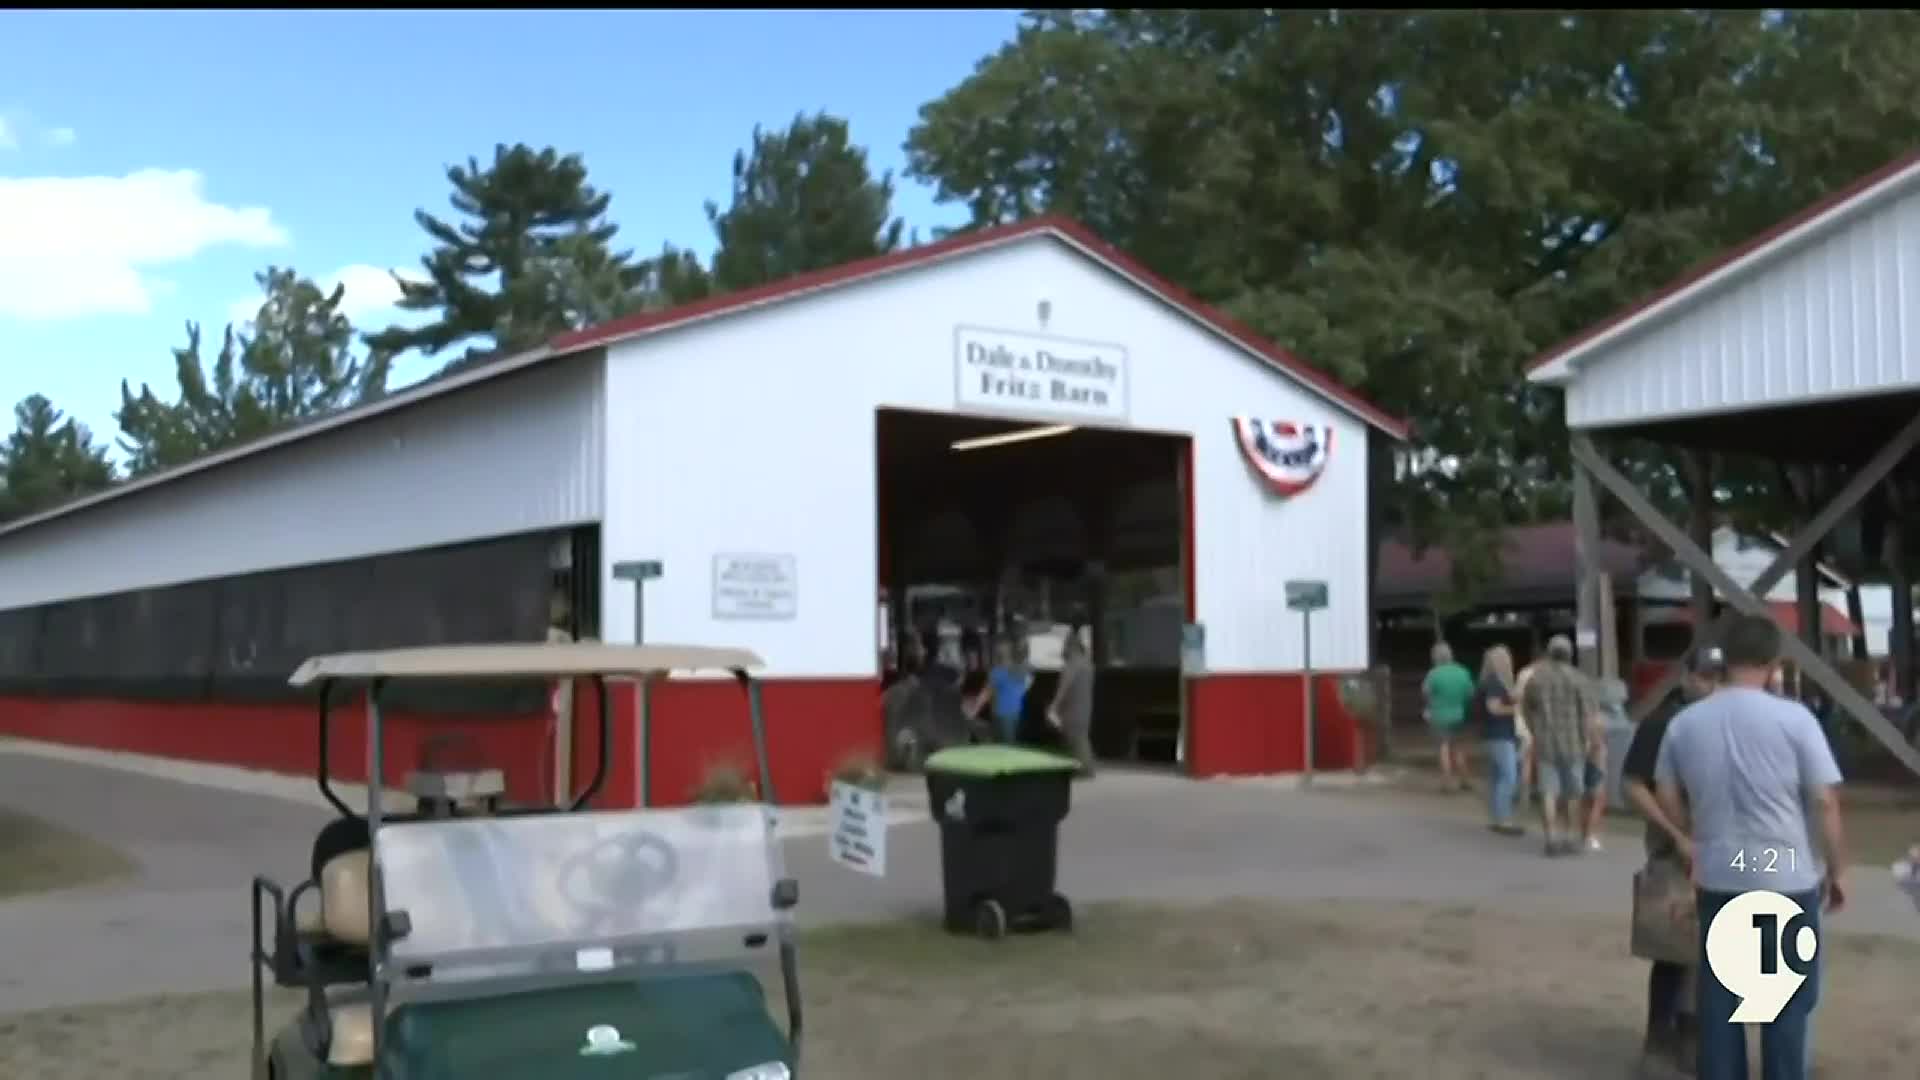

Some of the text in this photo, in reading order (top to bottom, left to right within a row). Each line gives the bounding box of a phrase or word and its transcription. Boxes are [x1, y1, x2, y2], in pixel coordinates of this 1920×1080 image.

[966, 341, 1015, 370] Dale
[980, 372, 1109, 406] Fritz Barn
